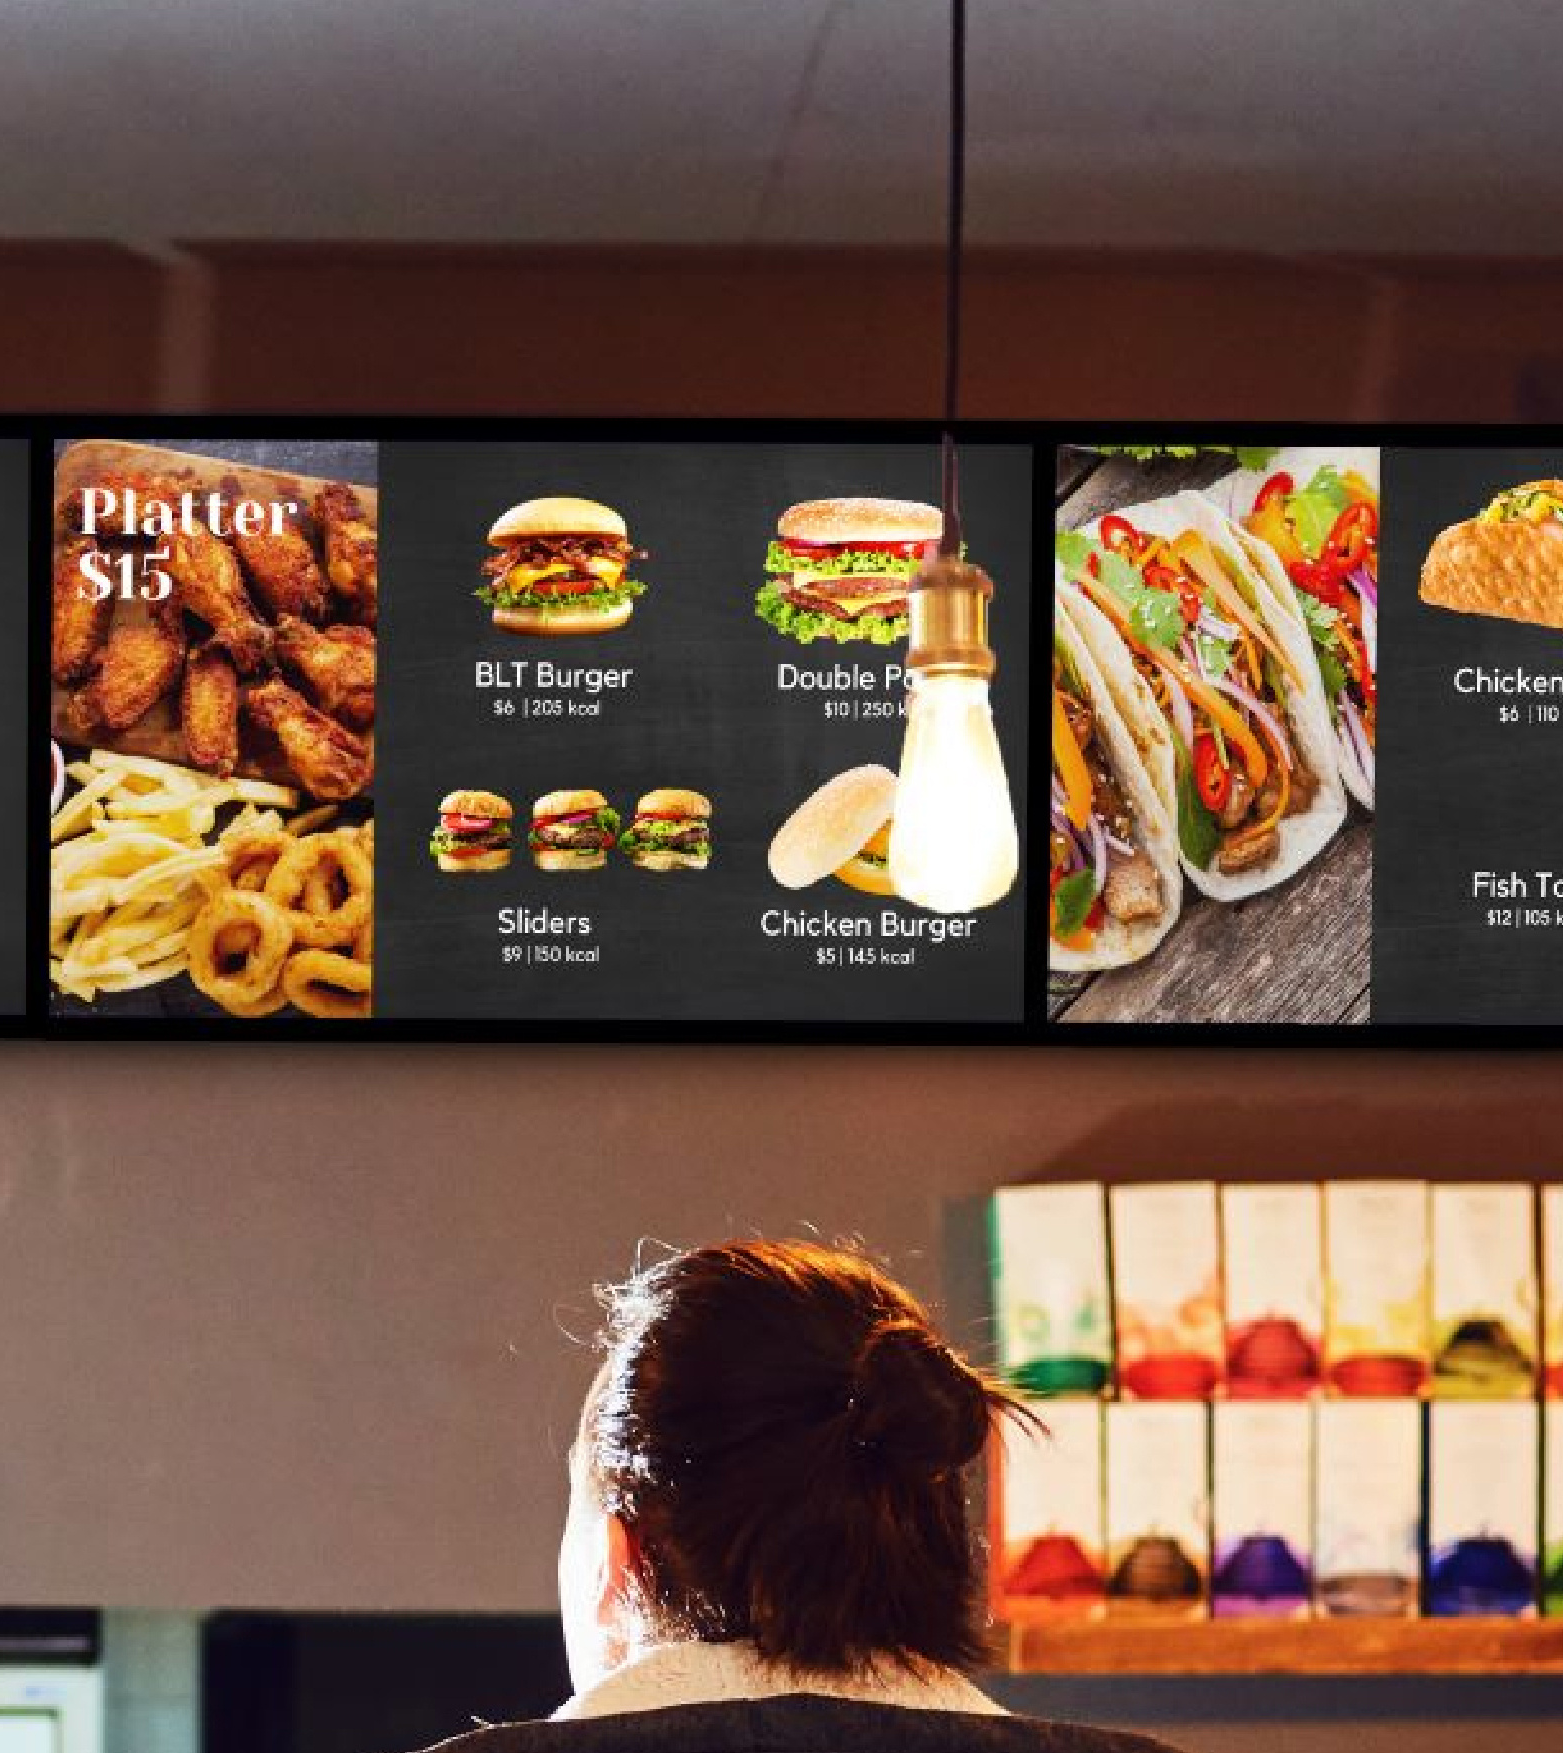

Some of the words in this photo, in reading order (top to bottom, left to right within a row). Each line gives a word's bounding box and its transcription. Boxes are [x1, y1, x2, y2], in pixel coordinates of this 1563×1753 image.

[82, 488, 297, 536] Platter
[80, 546, 172, 600] $15
[476, 662, 528, 687] BLT
[538, 662, 633, 692] Burger
[778, 664, 876, 690] Double
[1454, 667, 1563, 695] Chicken
[494, 700, 515, 715] $6
[569, 700, 599, 715] kcal
[825, 700, 850, 718] $10
[863, 700, 894, 718] 250
[1500, 705, 1518, 723] $6
[1472, 872, 1526, 897] Fish
[499, 907, 592, 933] Sliders
[761, 910, 871, 936] Chicken
[881, 910, 977, 943] Burger
[1488, 910, 1511, 925] $12
[566, 946, 599, 961] kcal
[817, 948, 835, 964] $5
[848, 948, 876, 964] 145
[881, 948, 914, 964] kcal
